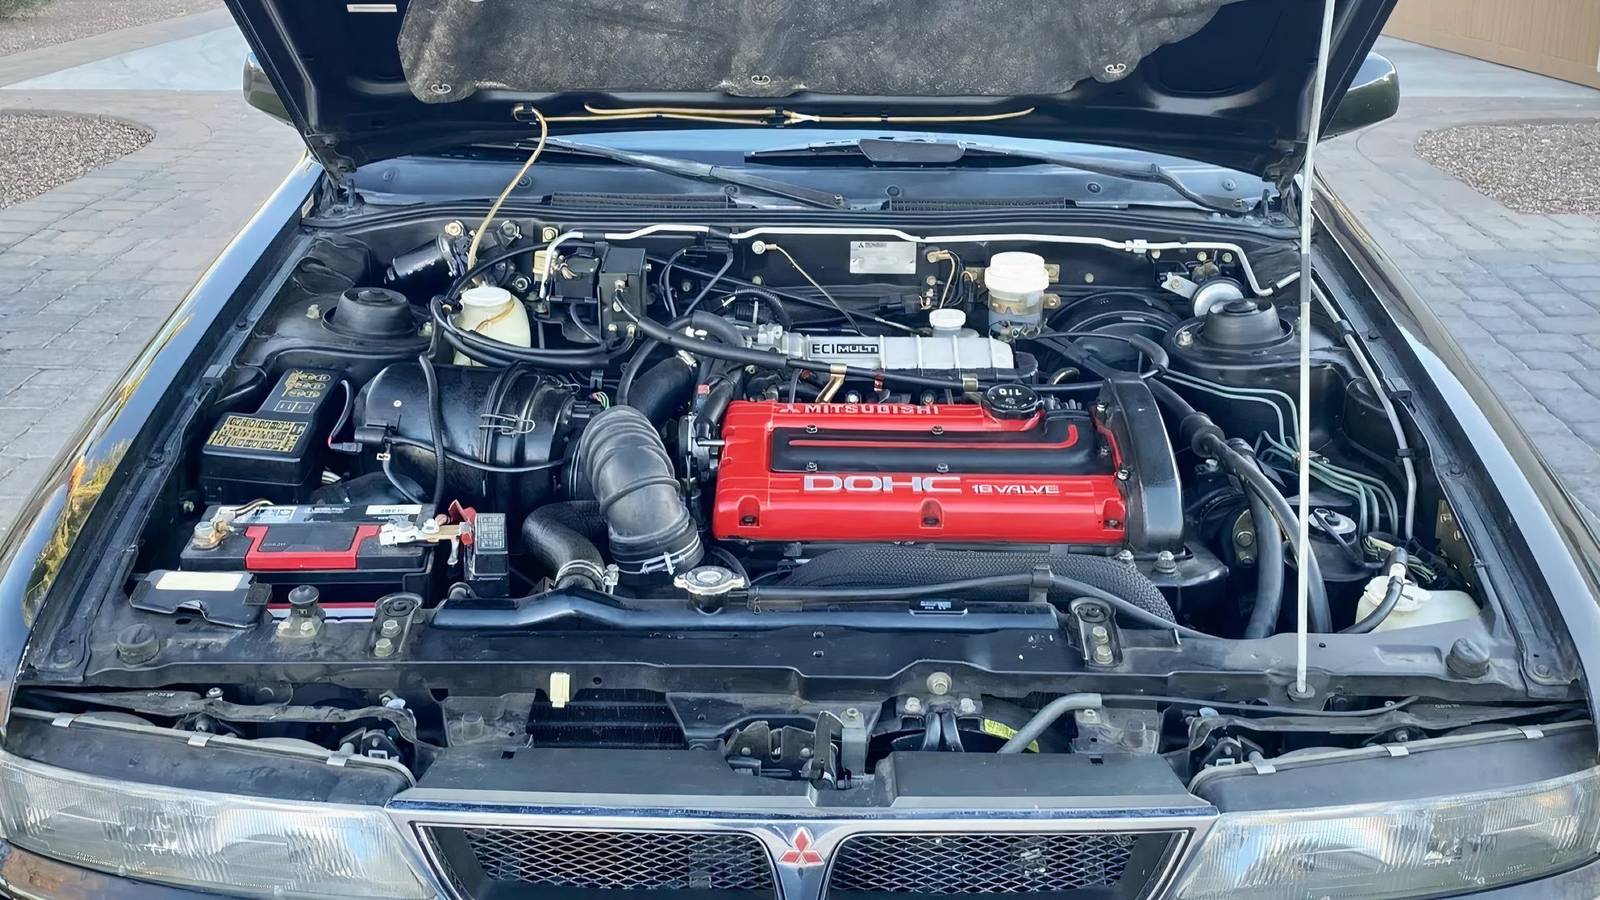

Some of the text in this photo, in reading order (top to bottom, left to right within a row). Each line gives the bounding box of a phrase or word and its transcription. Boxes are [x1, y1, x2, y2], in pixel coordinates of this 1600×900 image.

[812, 343, 878, 354] ECI MULTI
[999, 388, 1022, 396] OIL
[804, 403, 940, 415] MITSUBISHI
[804, 475, 961, 494] DOHC
